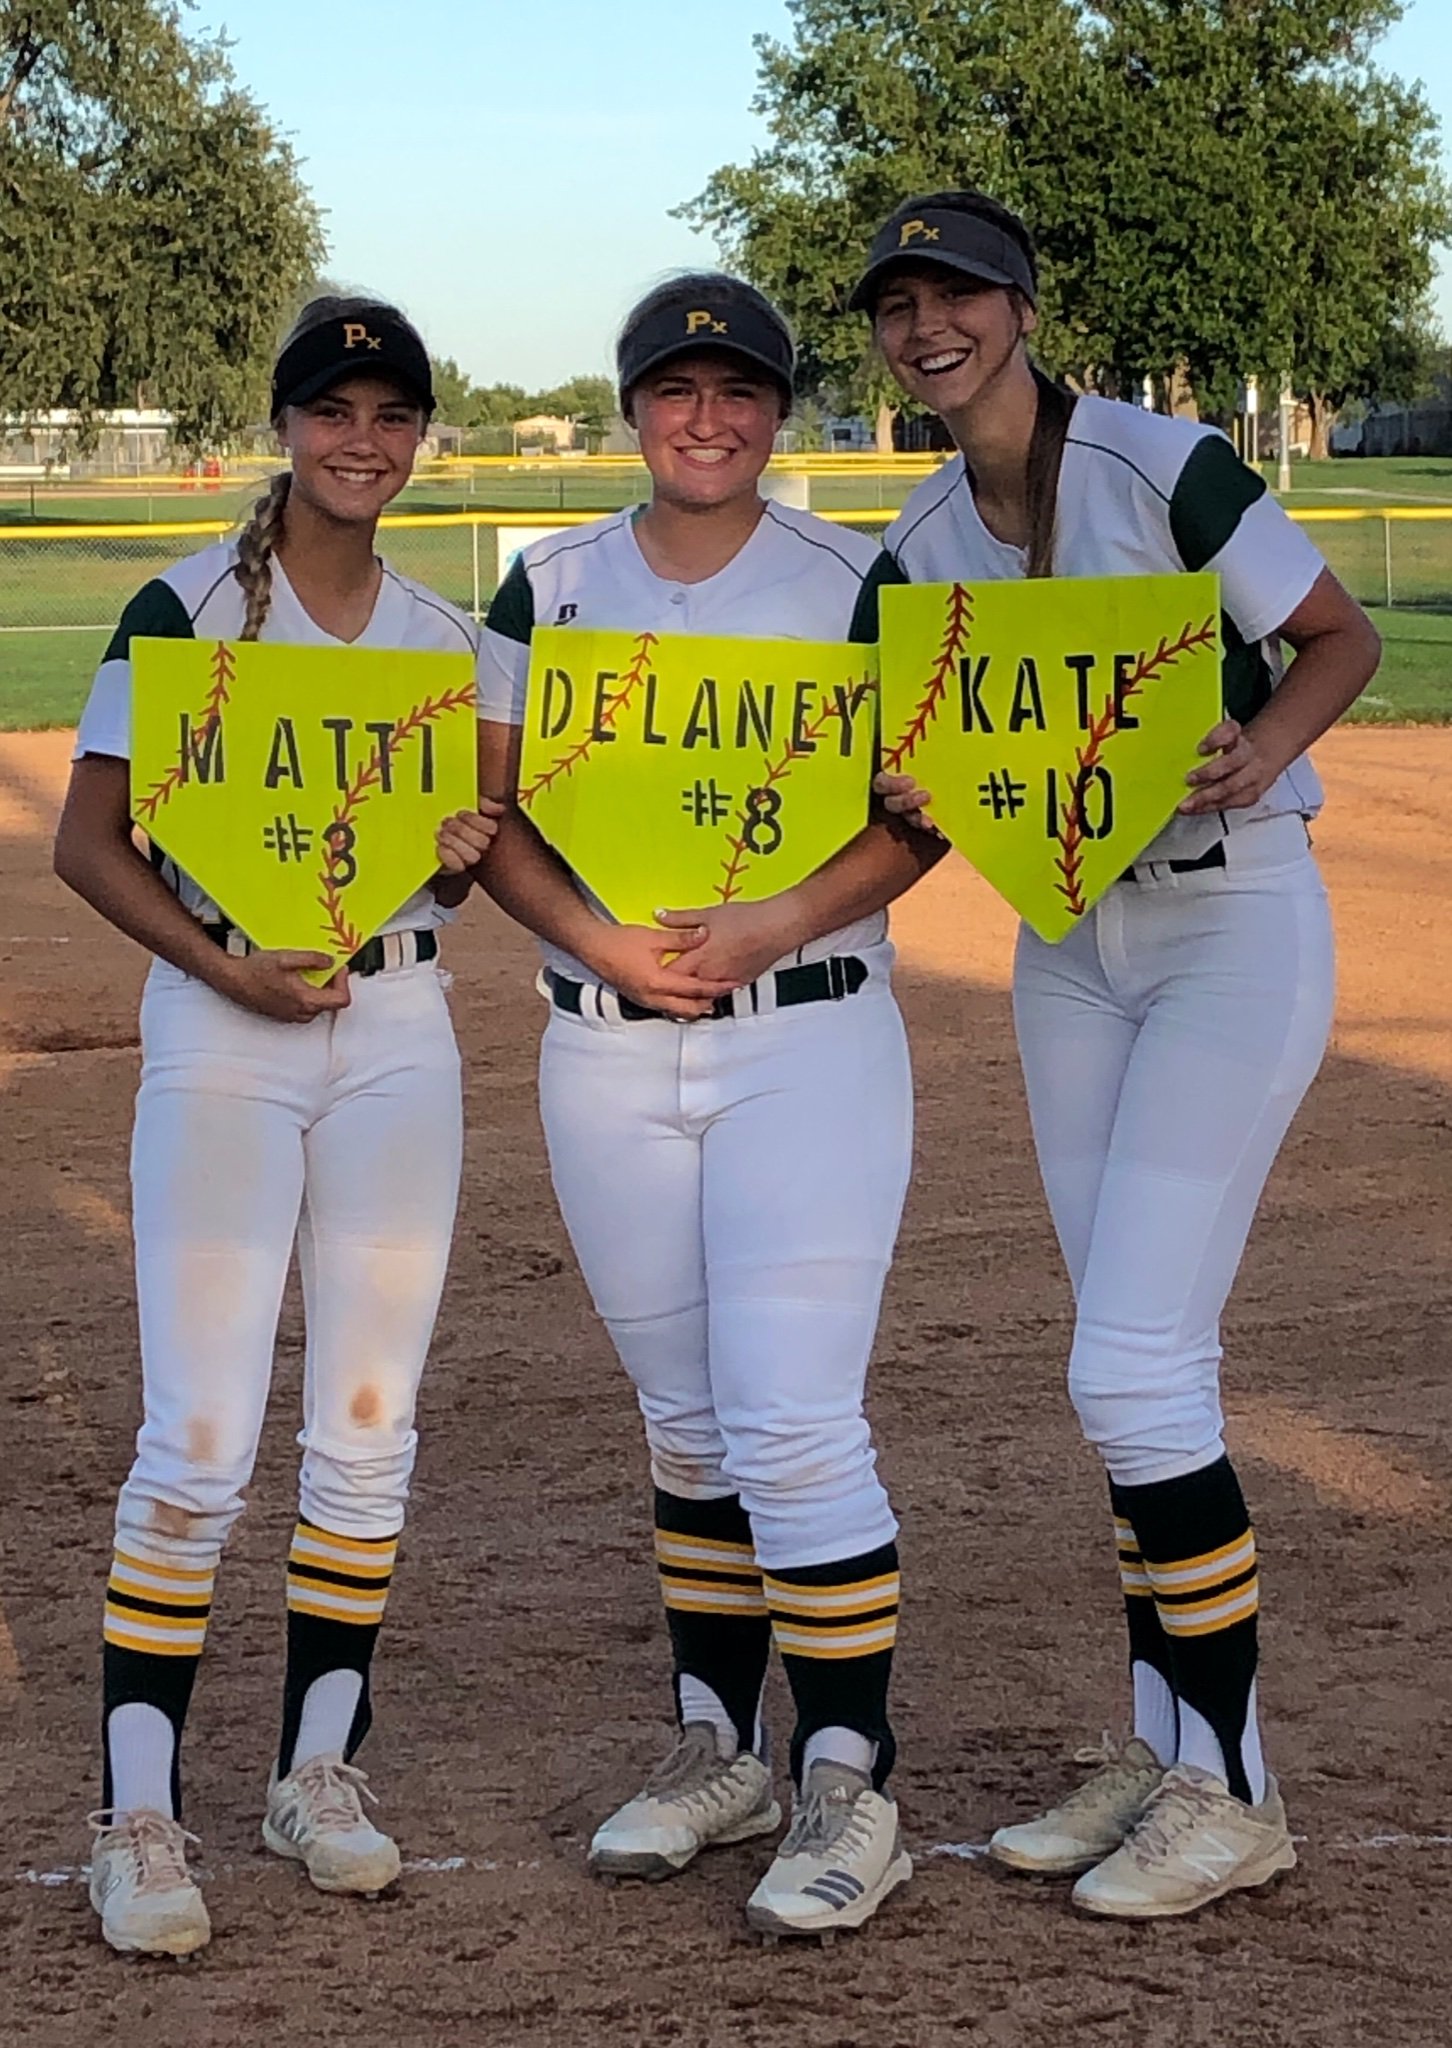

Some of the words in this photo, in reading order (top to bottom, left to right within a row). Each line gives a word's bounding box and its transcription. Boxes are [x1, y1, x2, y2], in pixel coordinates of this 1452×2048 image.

[343, 323, 382, 350] Px
[540, 668, 869, 757] DELANEY
[959, 654, 1139, 733] KATE
[179, 712, 434, 793] MATTI
[682, 778, 782, 855] #8
[978, 766, 1113, 839] #10
